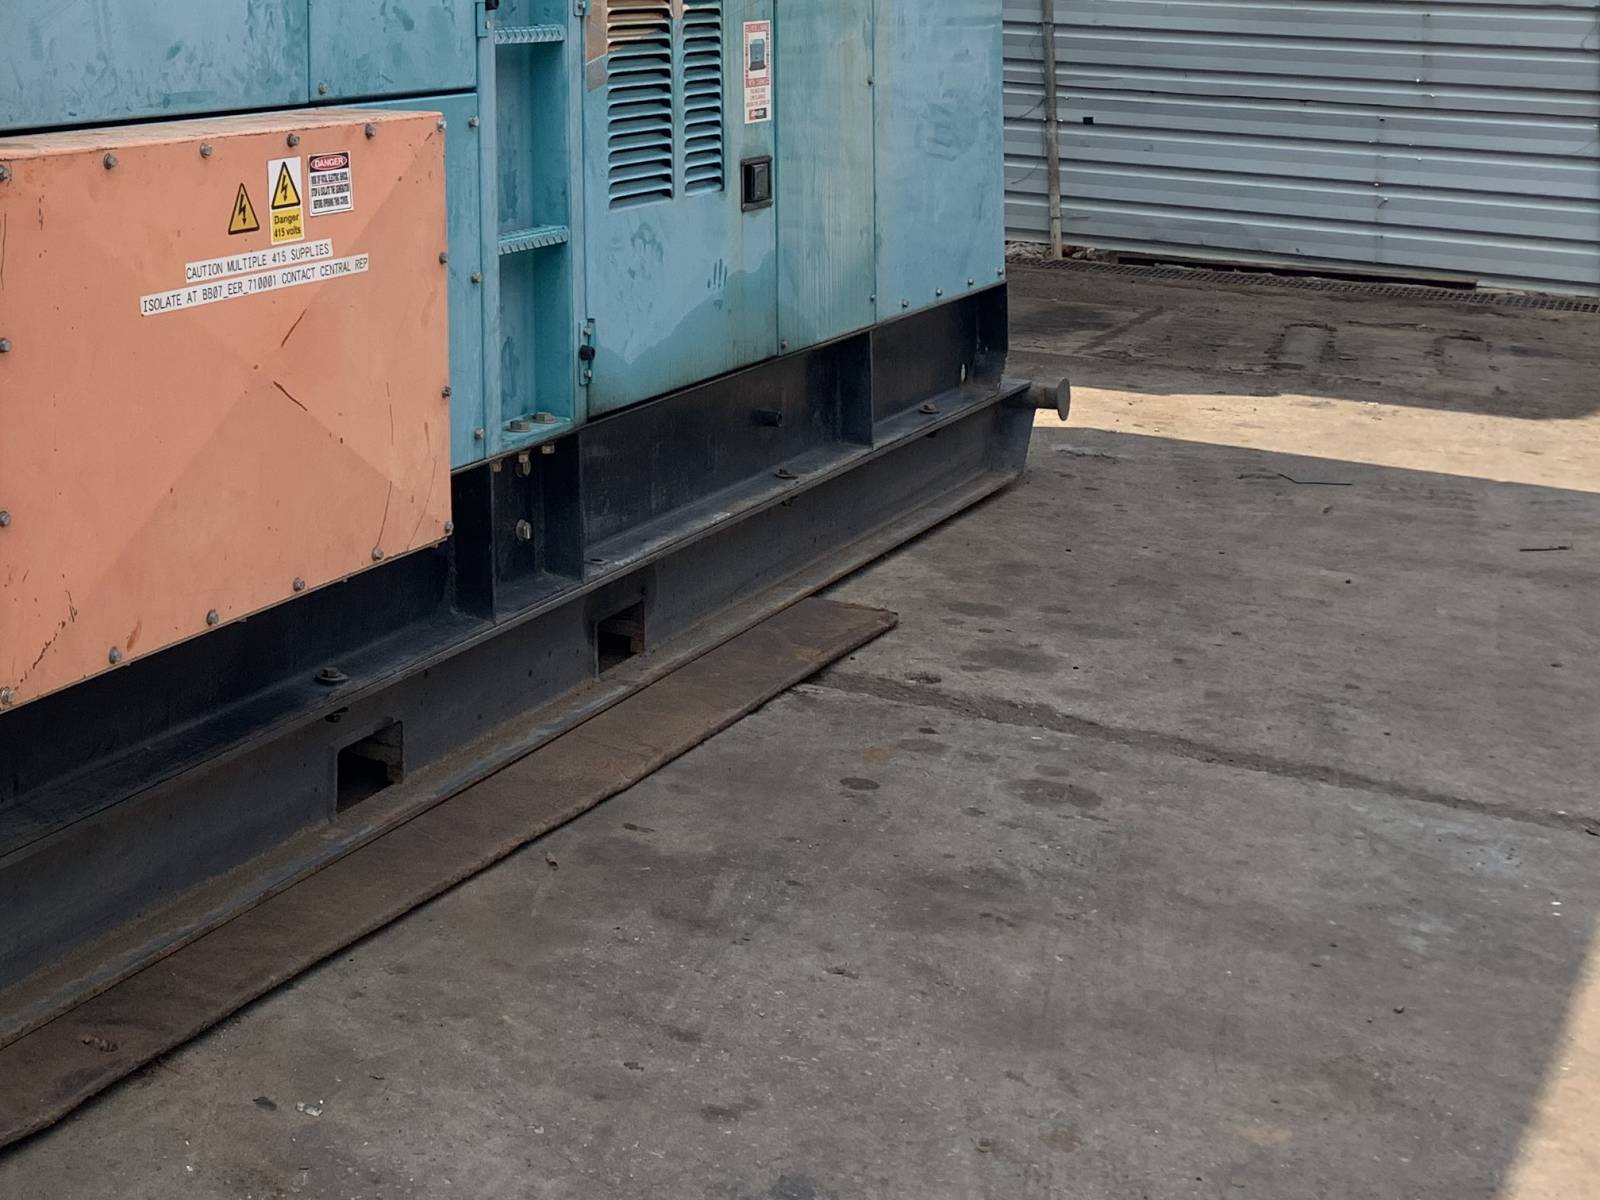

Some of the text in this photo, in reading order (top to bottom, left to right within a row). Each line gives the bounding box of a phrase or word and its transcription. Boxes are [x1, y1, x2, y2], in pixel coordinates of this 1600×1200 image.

[314, 157, 344, 168] DANGER
[274, 213, 299, 224] Danger
[274, 225, 301, 238] 415 volts
[186, 242, 329, 280] CAUTION MULTIPLE 415 SUPPLIES
[143, 294, 182, 313] ISOLATE
[186, 290, 197, 304] AT
[281, 267, 315, 285] CONTACT
[320, 260, 351, 277] CENTRAL
